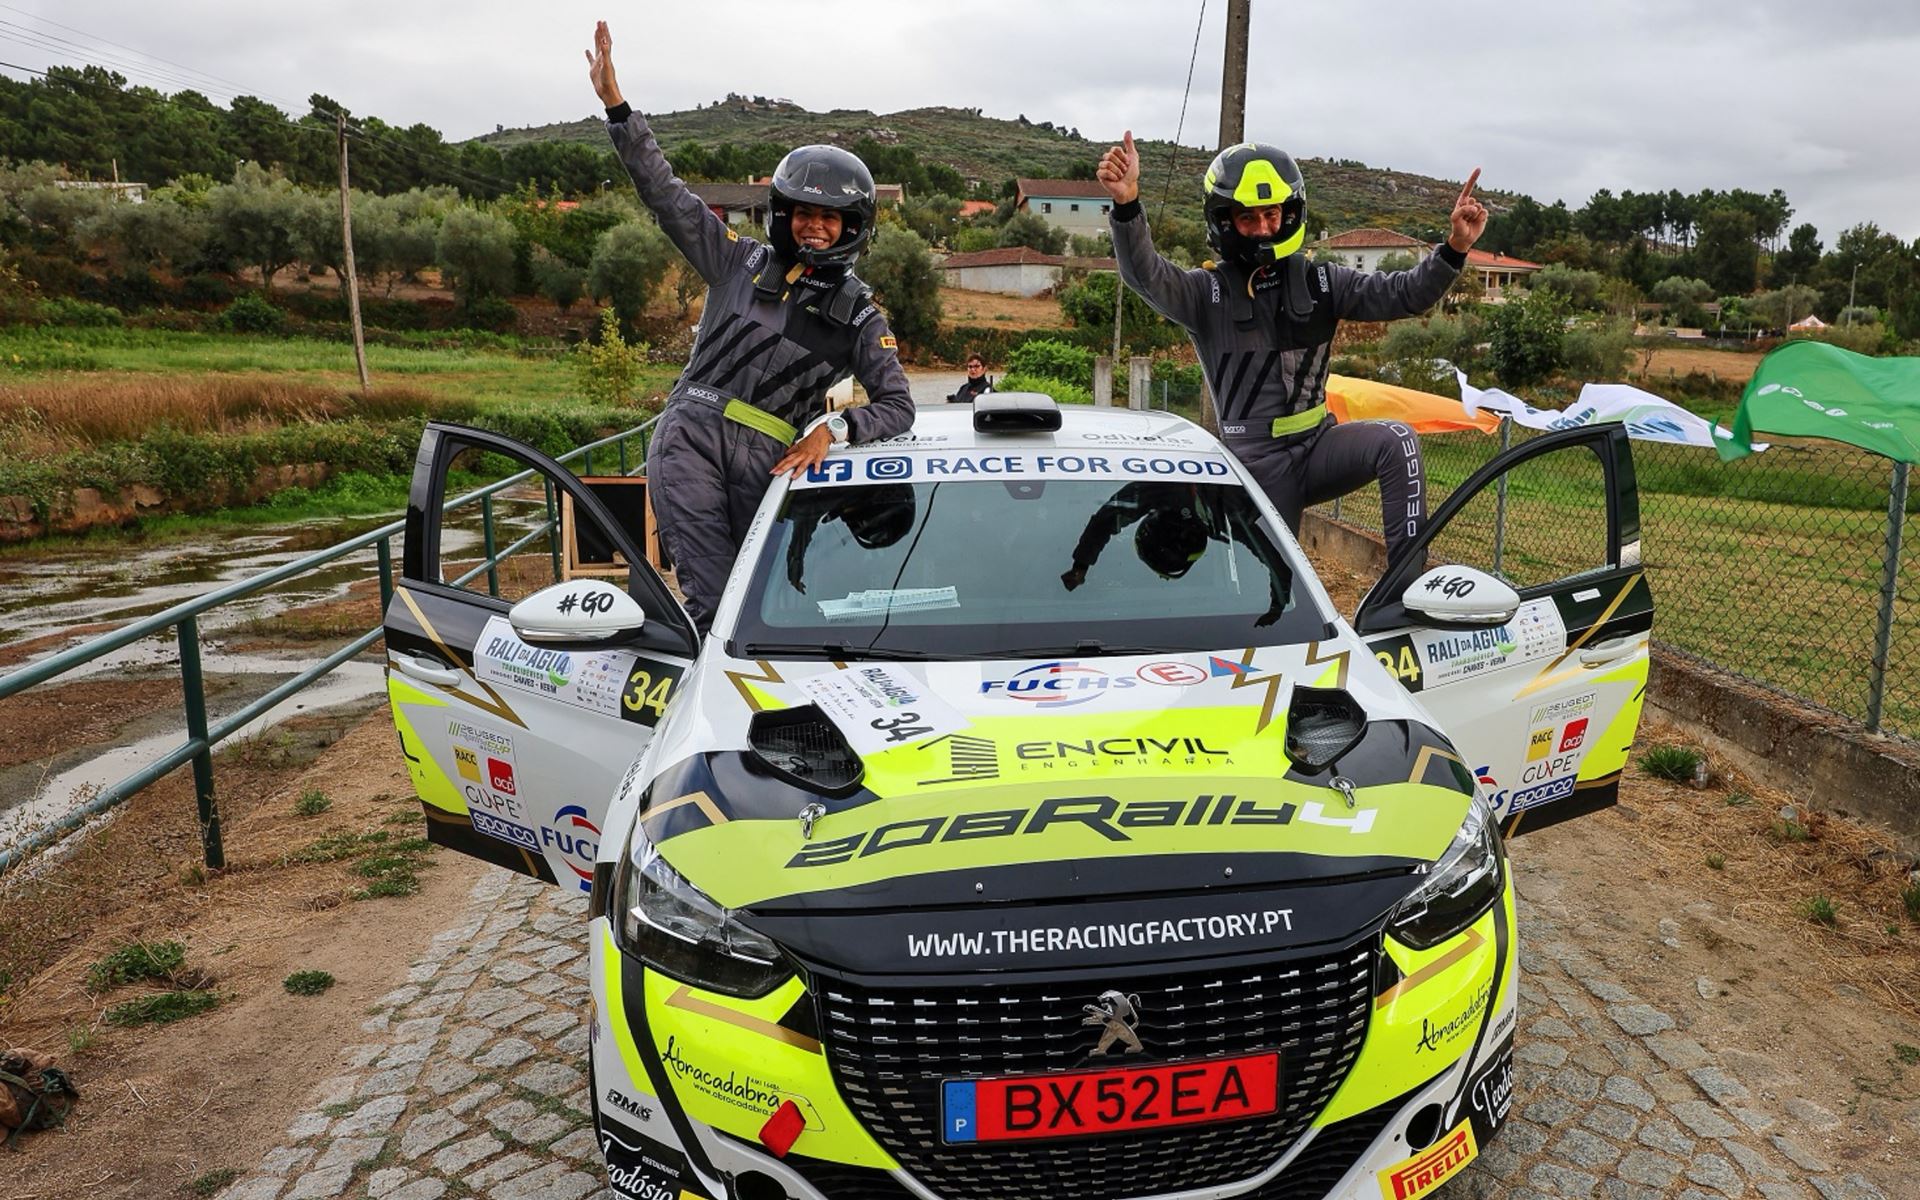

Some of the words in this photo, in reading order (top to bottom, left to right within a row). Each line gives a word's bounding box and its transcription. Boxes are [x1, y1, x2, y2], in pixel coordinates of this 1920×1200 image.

[1081, 432, 1194, 446] Odivelas
[926, 457, 1024, 476] RACE
[1038, 456, 1113, 474] FOR
[1121, 457, 1229, 477] GOOD
[1424, 575, 1476, 600] #GO
[556, 590, 615, 619] #GO
[485, 636, 521, 662] RALI
[1426, 637, 1461, 664] RALI
[623, 670, 668, 717] 34
[979, 675, 1138, 695] FUCHS
[1548, 692, 1597, 711] PEUGEOT
[460, 724, 512, 746] PEUGEOT
[870, 712, 935, 742] 34
[1531, 729, 1554, 747] RACC
[455, 748, 477, 766] RACC
[1016, 737, 1230, 761] ENCIVIL
[1020, 757, 1236, 771] ENGENHARIA
[1513, 777, 1575, 808] sparco
[472, 811, 536, 845] sparco
[906, 908, 1295, 958] WWW.THERACINGFACTORY.PT
[661, 1035, 782, 1110] Abracadabra
[954, 1118, 968, 1133] P
[1390, 1129, 1471, 1200] PIRELLI
